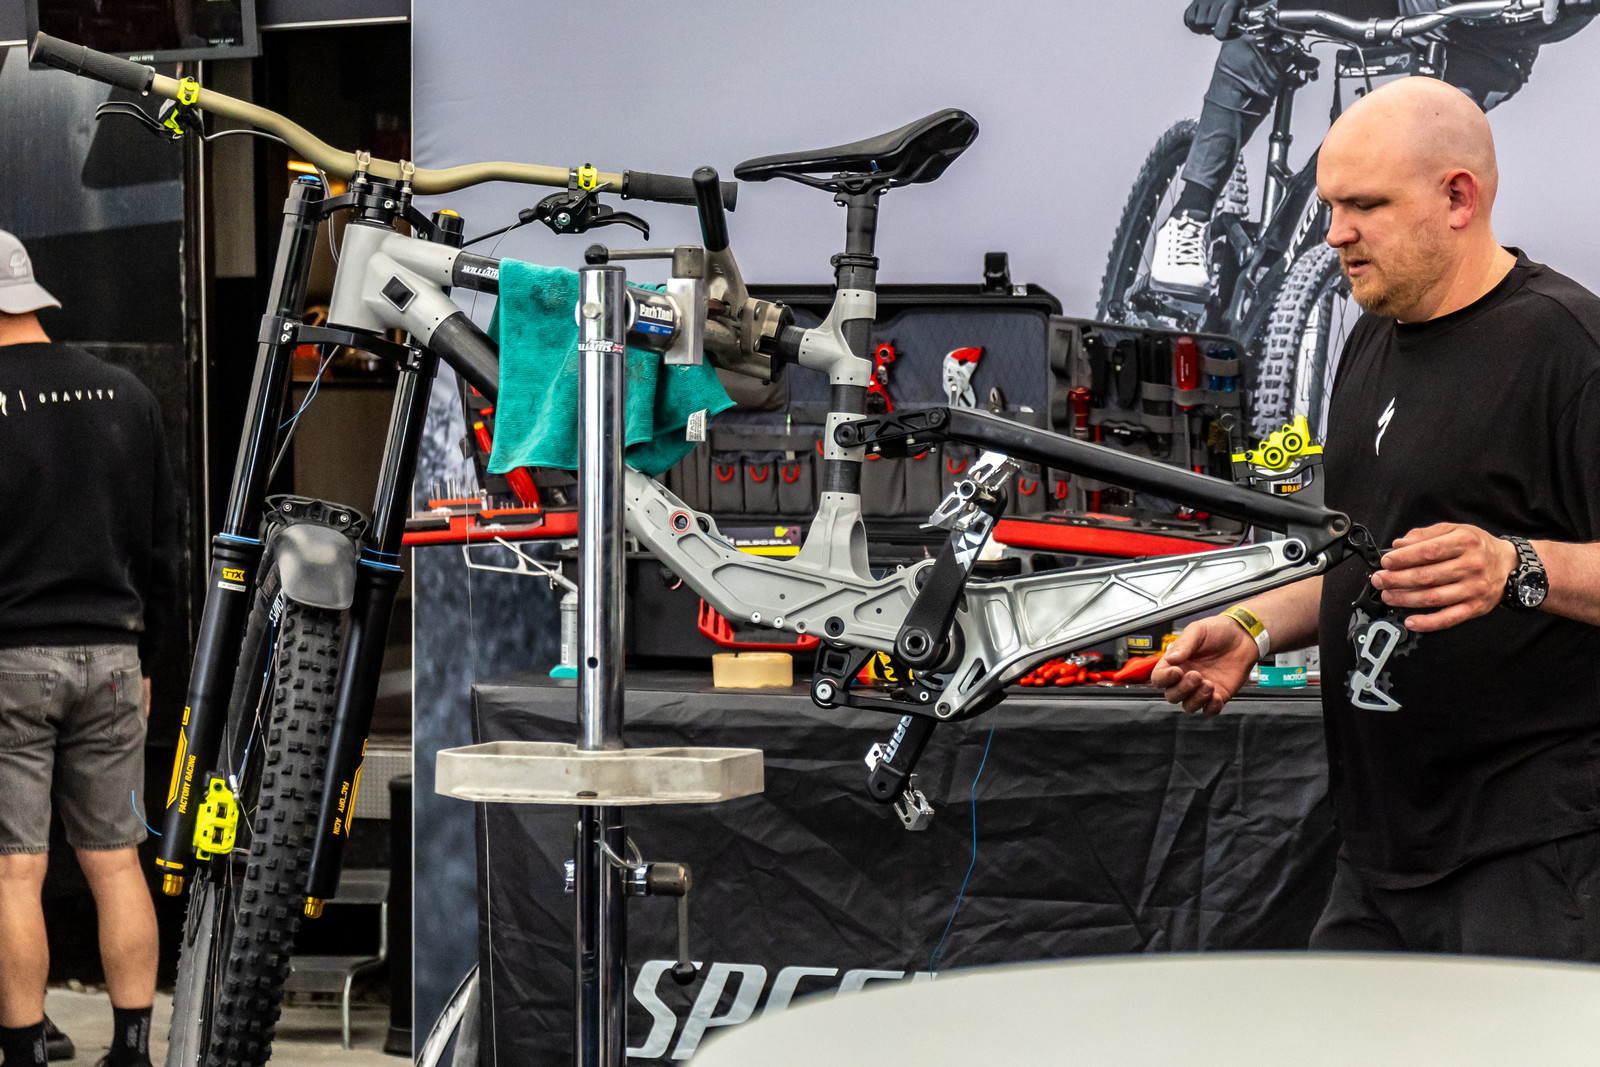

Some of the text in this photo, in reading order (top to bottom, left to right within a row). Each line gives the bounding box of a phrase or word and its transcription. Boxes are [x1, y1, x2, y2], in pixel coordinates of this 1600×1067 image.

[224, 570, 243, 580] TTX
[178, 754, 197, 814] FACTORY RACING
[337, 780, 350, 813] FACORY
